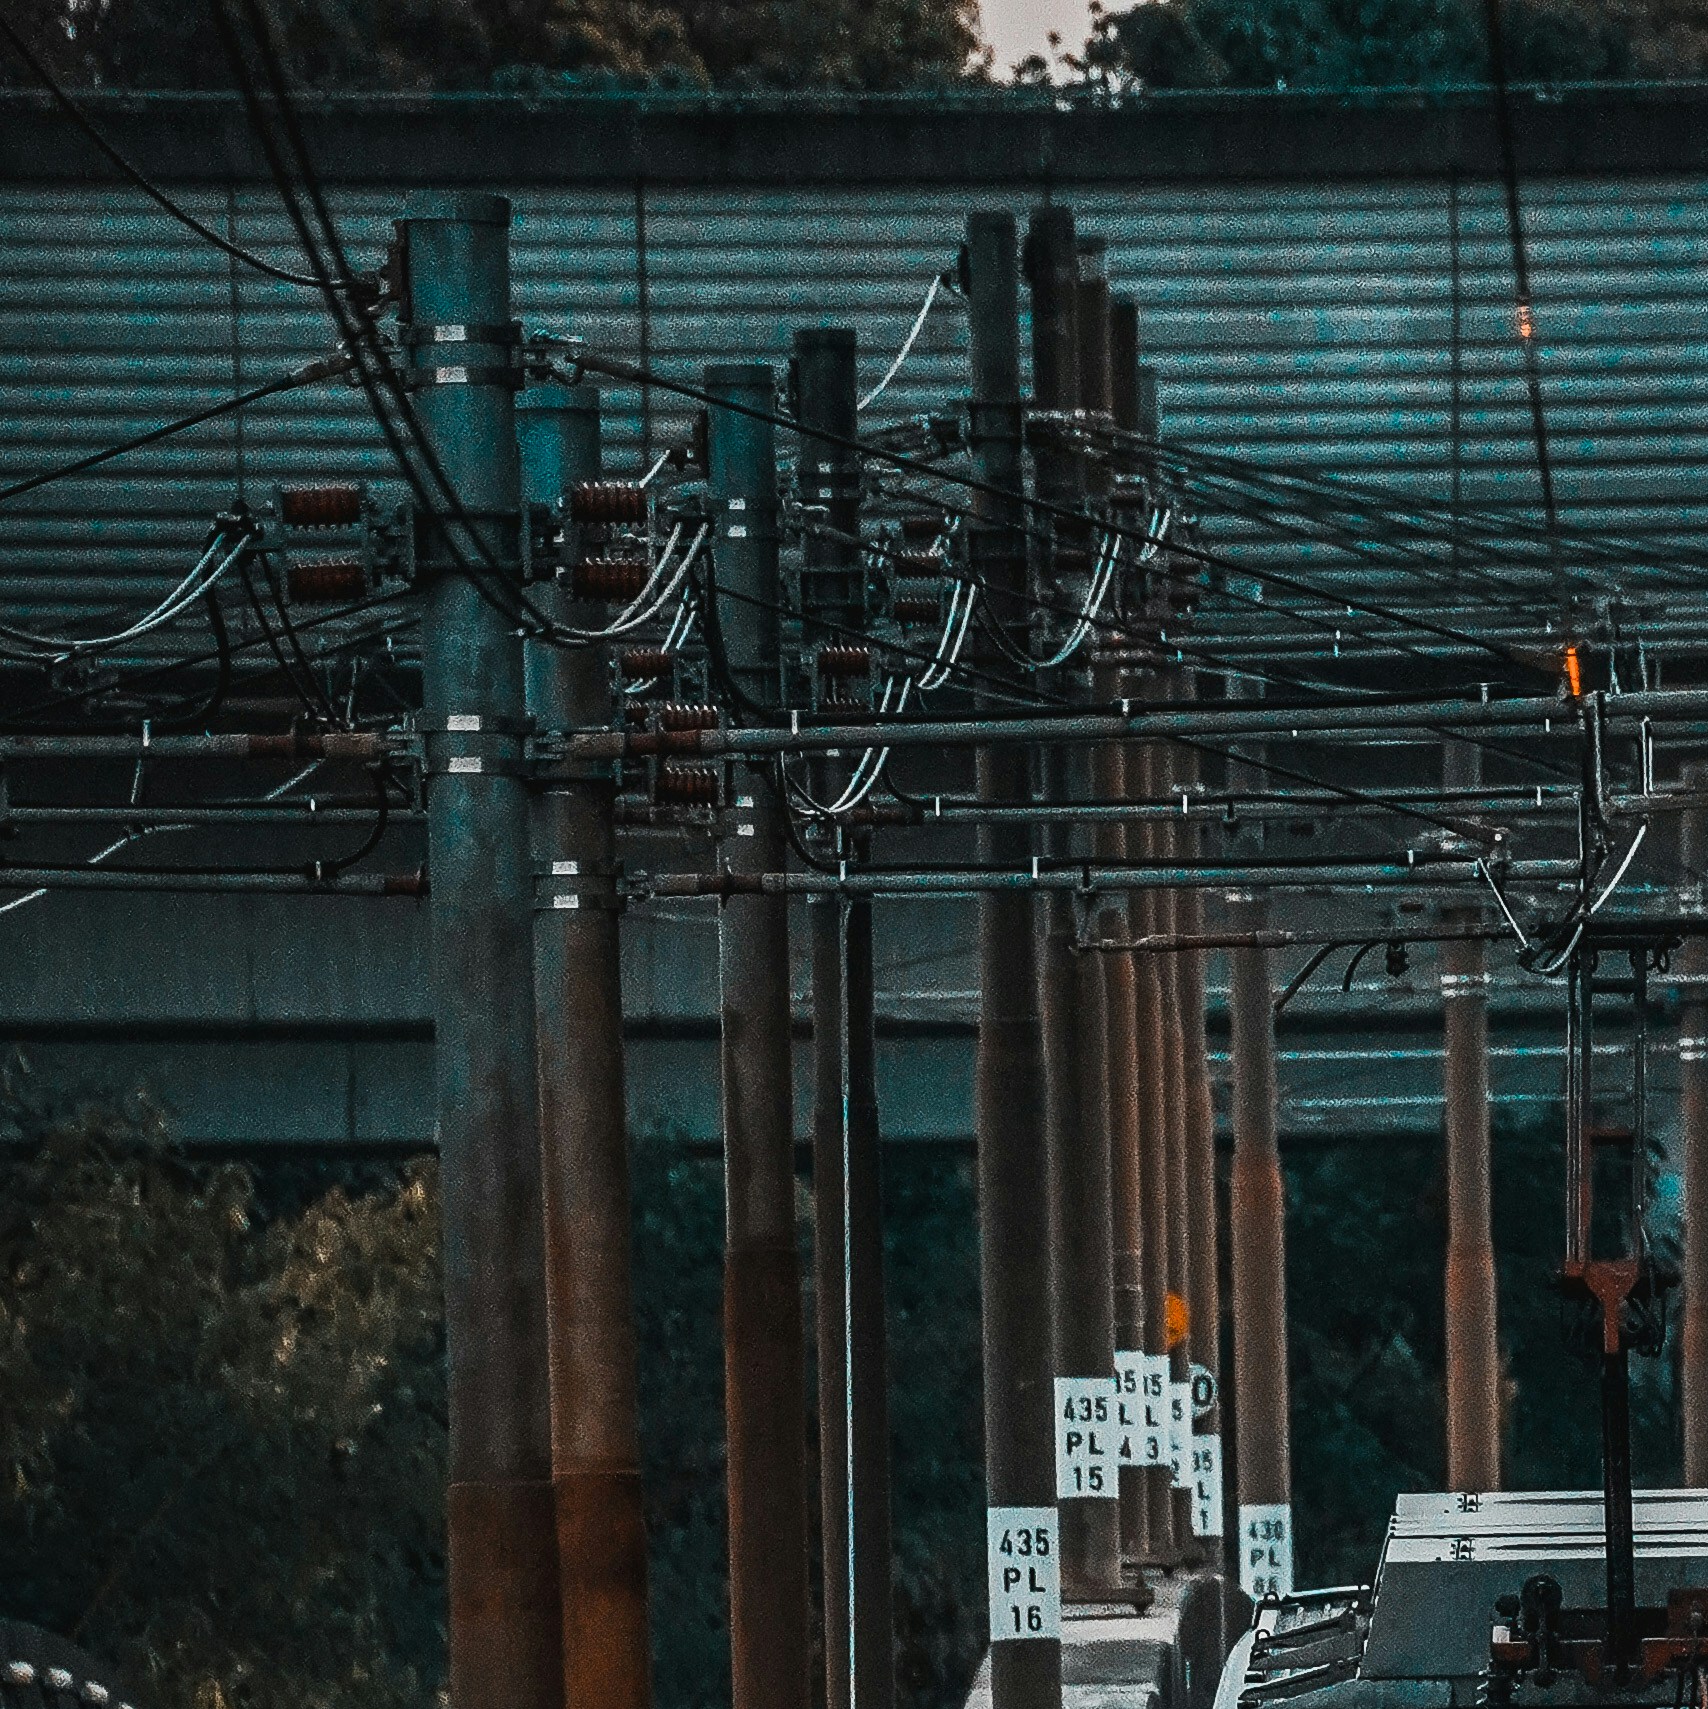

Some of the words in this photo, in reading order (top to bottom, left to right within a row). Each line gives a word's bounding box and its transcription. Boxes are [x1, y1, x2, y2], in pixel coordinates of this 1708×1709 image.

[1063, 1397, 1108, 1422] 435
[1066, 1432, 1104, 1455] PL
[1073, 1467, 1103, 1491] 15
[1000, 1529, 1050, 1556] 435
[1003, 1567, 1046, 1593] PL
[1011, 1605, 1041, 1632] 16
